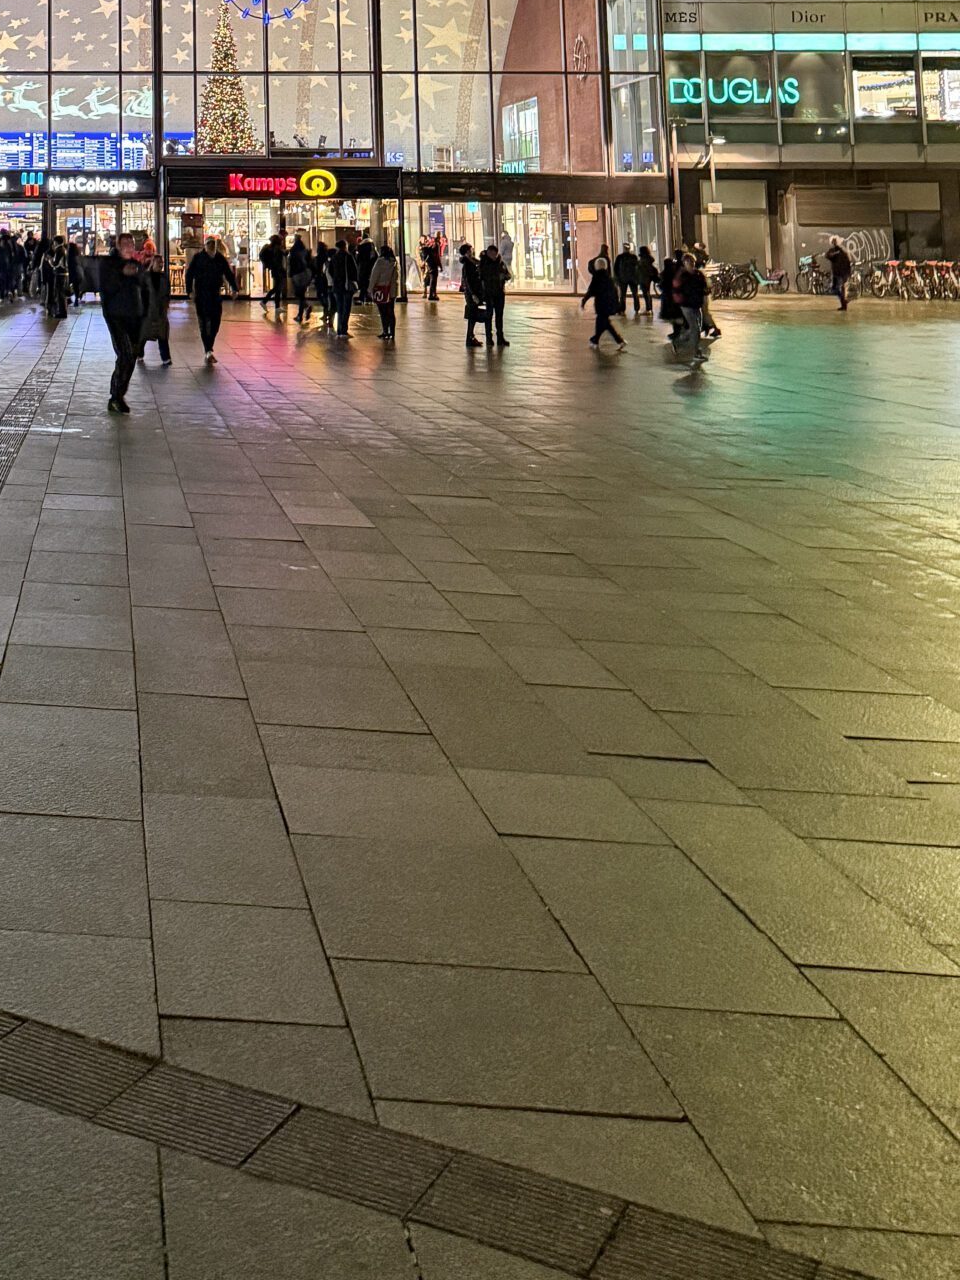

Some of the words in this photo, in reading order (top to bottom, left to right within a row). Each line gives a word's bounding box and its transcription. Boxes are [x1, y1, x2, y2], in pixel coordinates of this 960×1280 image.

[791, 10, 827, 24] Dior
[669, 77, 800, 105] DOUGLAS
[48, 177, 138, 195] NetCologne
[229, 173, 298, 195] Kamps
